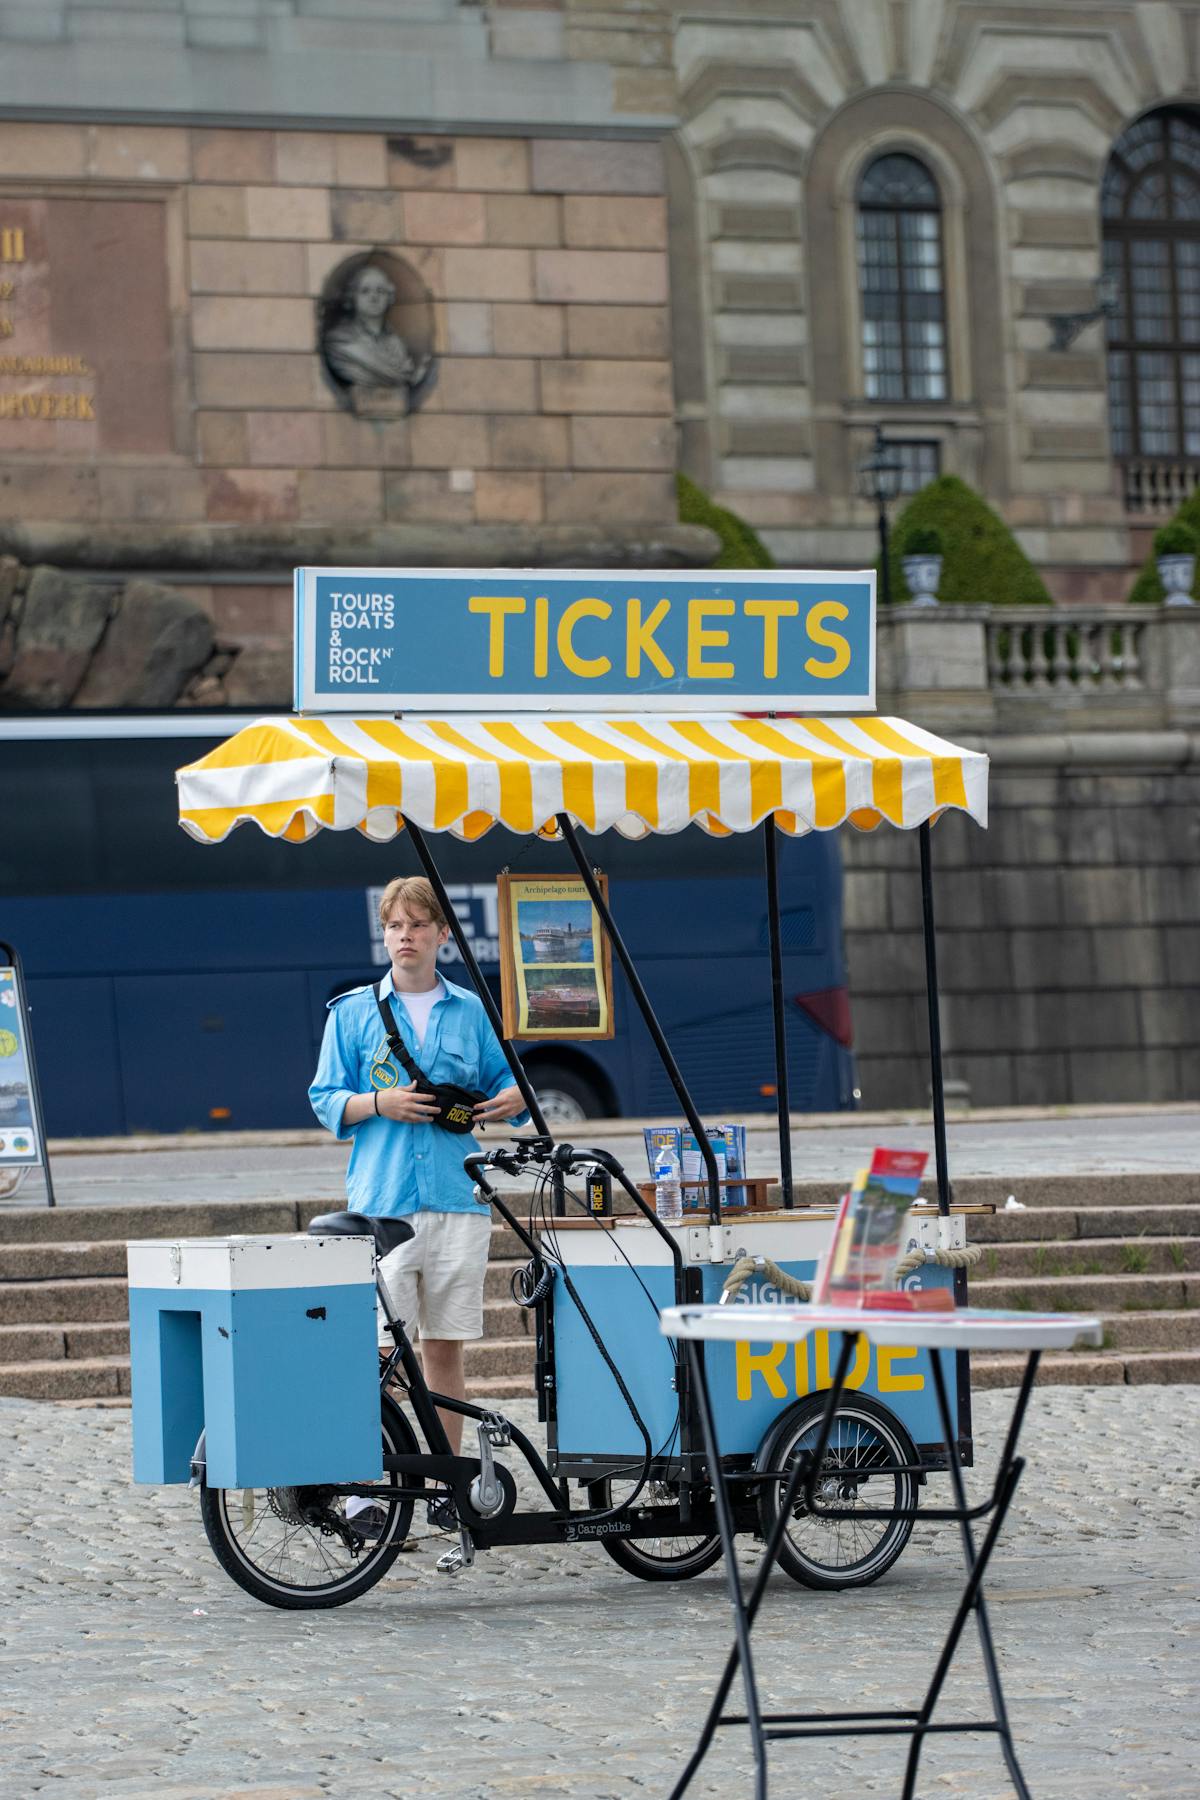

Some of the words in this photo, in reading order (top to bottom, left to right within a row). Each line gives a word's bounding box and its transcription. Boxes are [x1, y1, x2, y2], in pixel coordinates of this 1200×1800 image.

[329, 593, 395, 612] TOURS
[330, 611, 395, 630] BOATS
[329, 629, 342, 647] &
[467, 596, 852, 680] TICKETS
[329, 665, 379, 683] ROLL
[524, 885, 566, 896] Archipelago
[446, 1107, 472, 1124] RIDE
[593, 1184, 604, 1211] RIDE
[735, 1328, 925, 1401] RIDE
[577, 1521, 632, 1537] Cargobike
